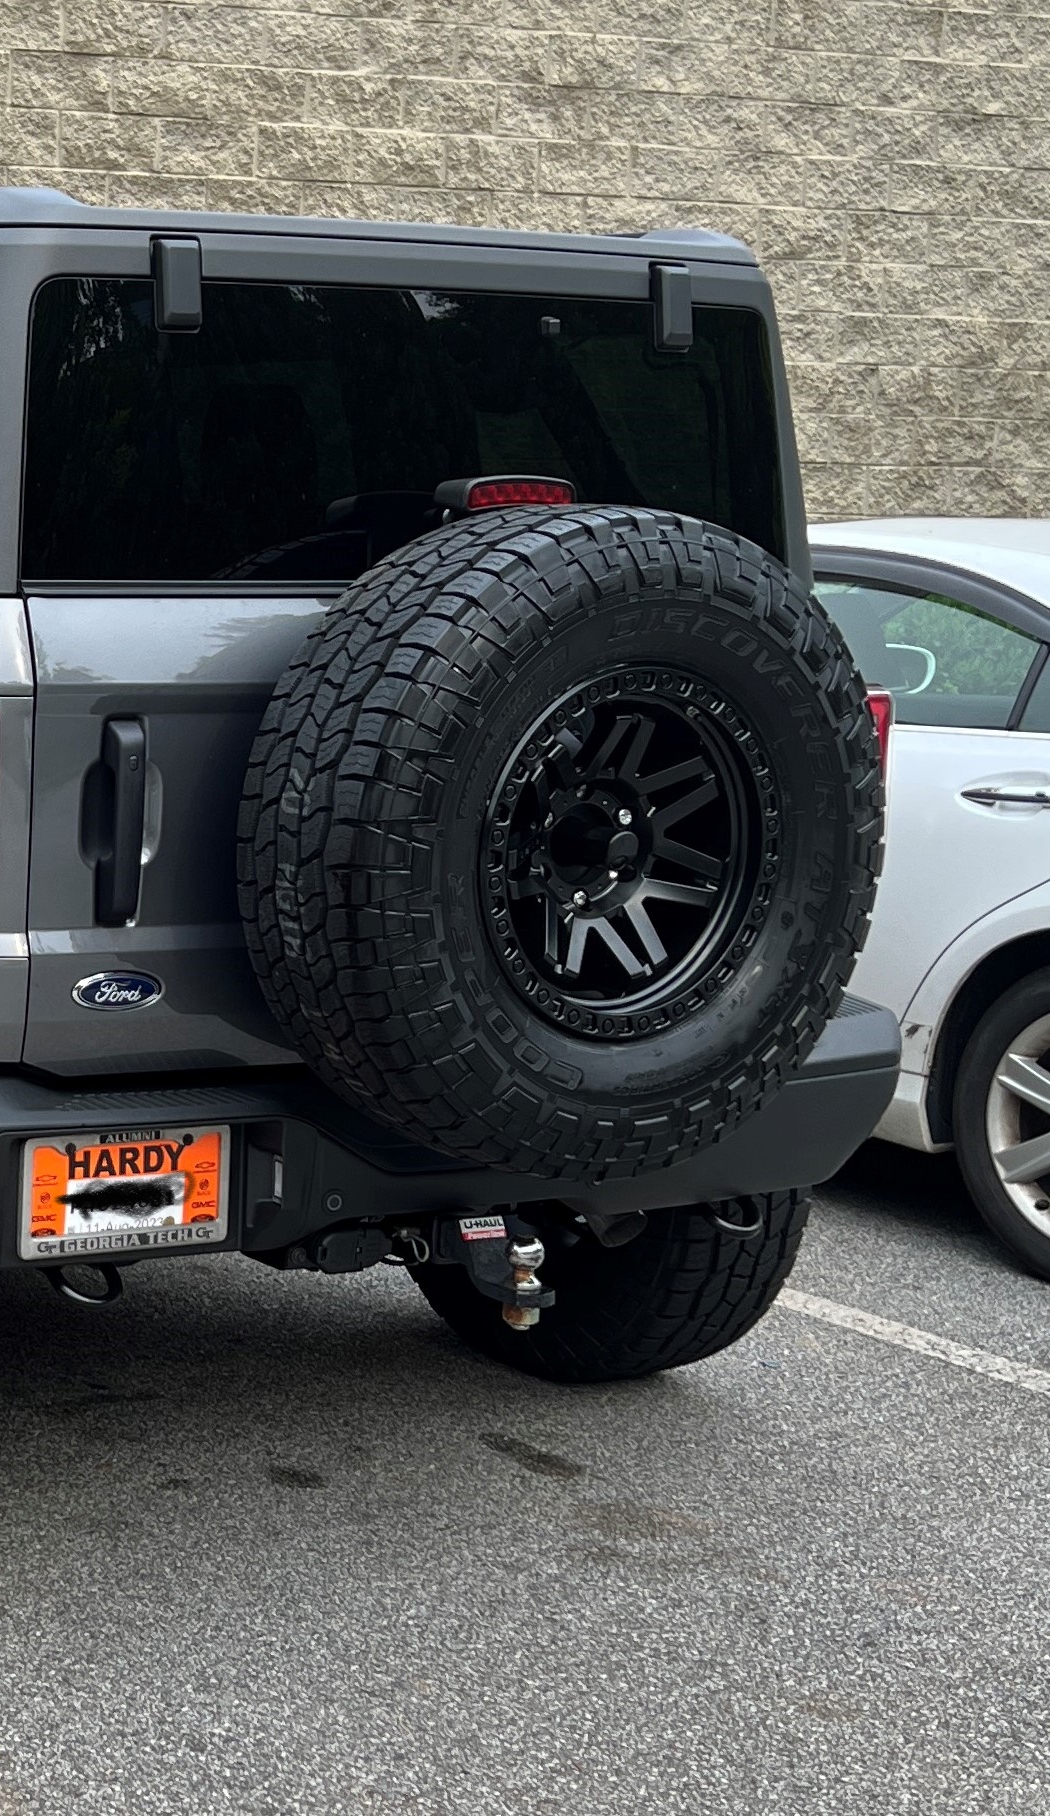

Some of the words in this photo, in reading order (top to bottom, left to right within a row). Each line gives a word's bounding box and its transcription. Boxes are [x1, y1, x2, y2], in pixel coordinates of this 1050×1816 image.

[607, 606, 838, 822] DISCOVERER
[94, 980, 142, 1003] Ford
[447, 871, 583, 1091] COOPER
[104, 1130, 156, 1144] ALUMNI
[68, 1143, 186, 1180] HARDY
[463, 1218, 504, 1229] U-HAUL
[64, 1233, 142, 1252] GEORGIA
[147, 1227, 191, 1245] TECH
